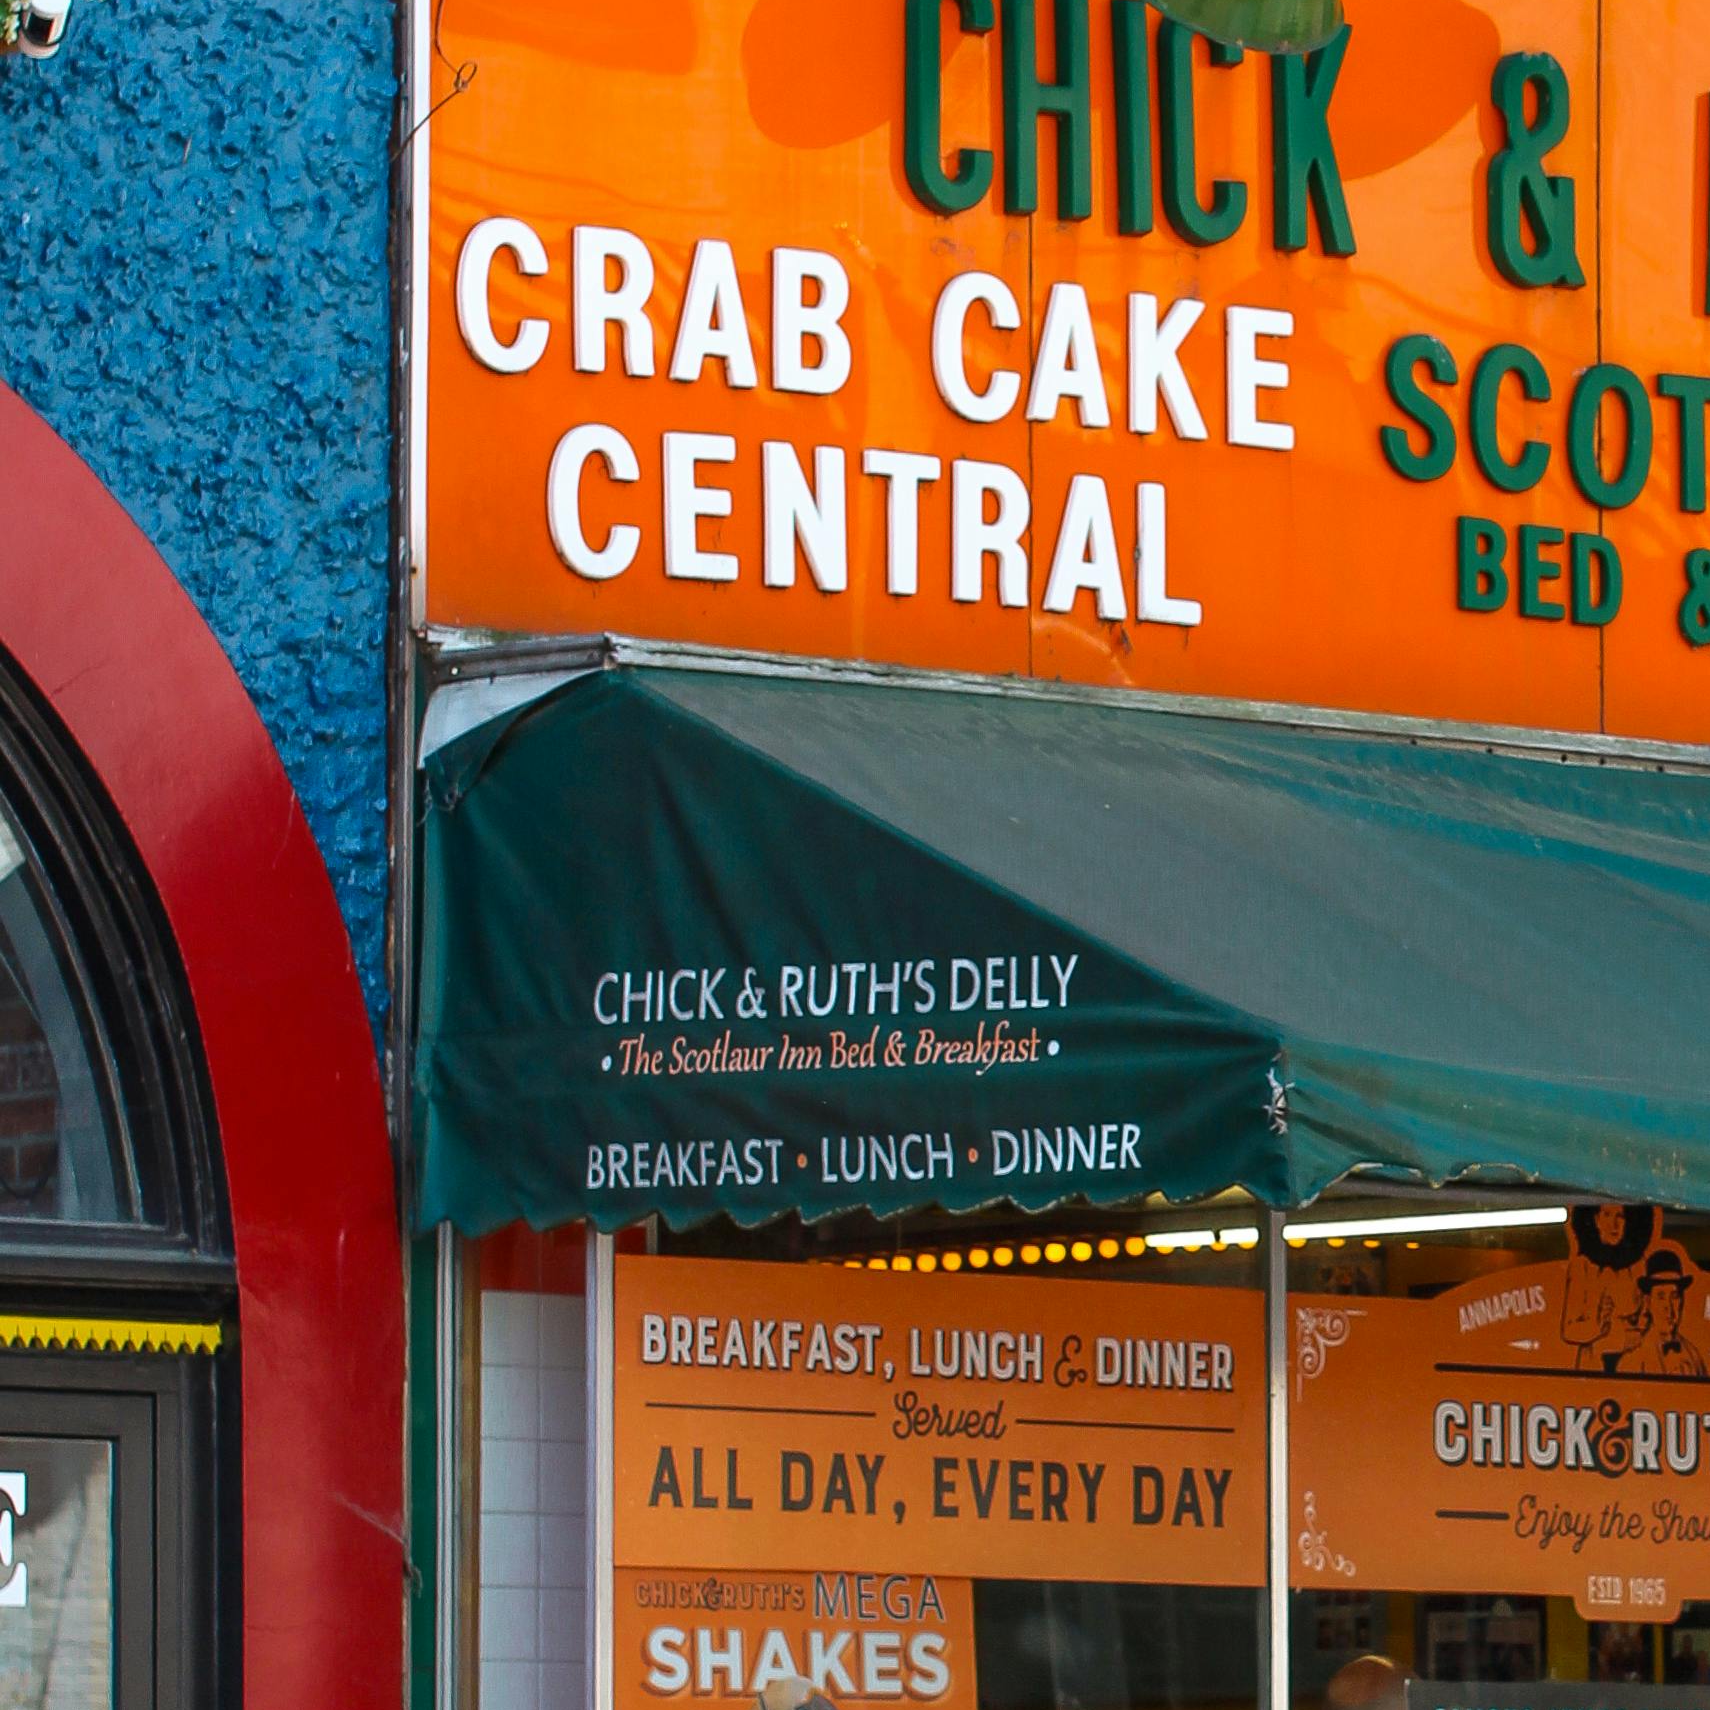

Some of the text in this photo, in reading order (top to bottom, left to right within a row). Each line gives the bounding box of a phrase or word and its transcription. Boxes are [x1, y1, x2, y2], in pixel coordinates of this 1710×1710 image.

[1488, 51, 1586, 289] &
[456, 217, 1295, 452] CRAB CAKE
[546, 423, 1203, 626] CENTRAL
[1457, 516, 1623, 627] BED
[593, 953, 1079, 1025] CHICK & RUTH'S DELLY
[619, 1020, 1040, 1076] The Scotlaur Inn Bed & Breakfast
[586, 1123, 1142, 1189] BREAKFAST LUNCH DINNER
[1458, 1284, 1546, 1334] ANNAPOLIS
[641, 1313, 1234, 1390] BREAKFAST, LUNCH & DINNER
[893, 1391, 1007, 1440] Served
[649, 1446, 1233, 1528] ALL DAY, EVERY DAY
[1515, 1495, 1594, 1554] Enjoy
[1600, 1499, 1644, 1540] the
[812, 1572, 945, 1622] MEGA
[1629, 1577, 1666, 1607] 1965
[645, 1626, 951, 1696] SHAKES
